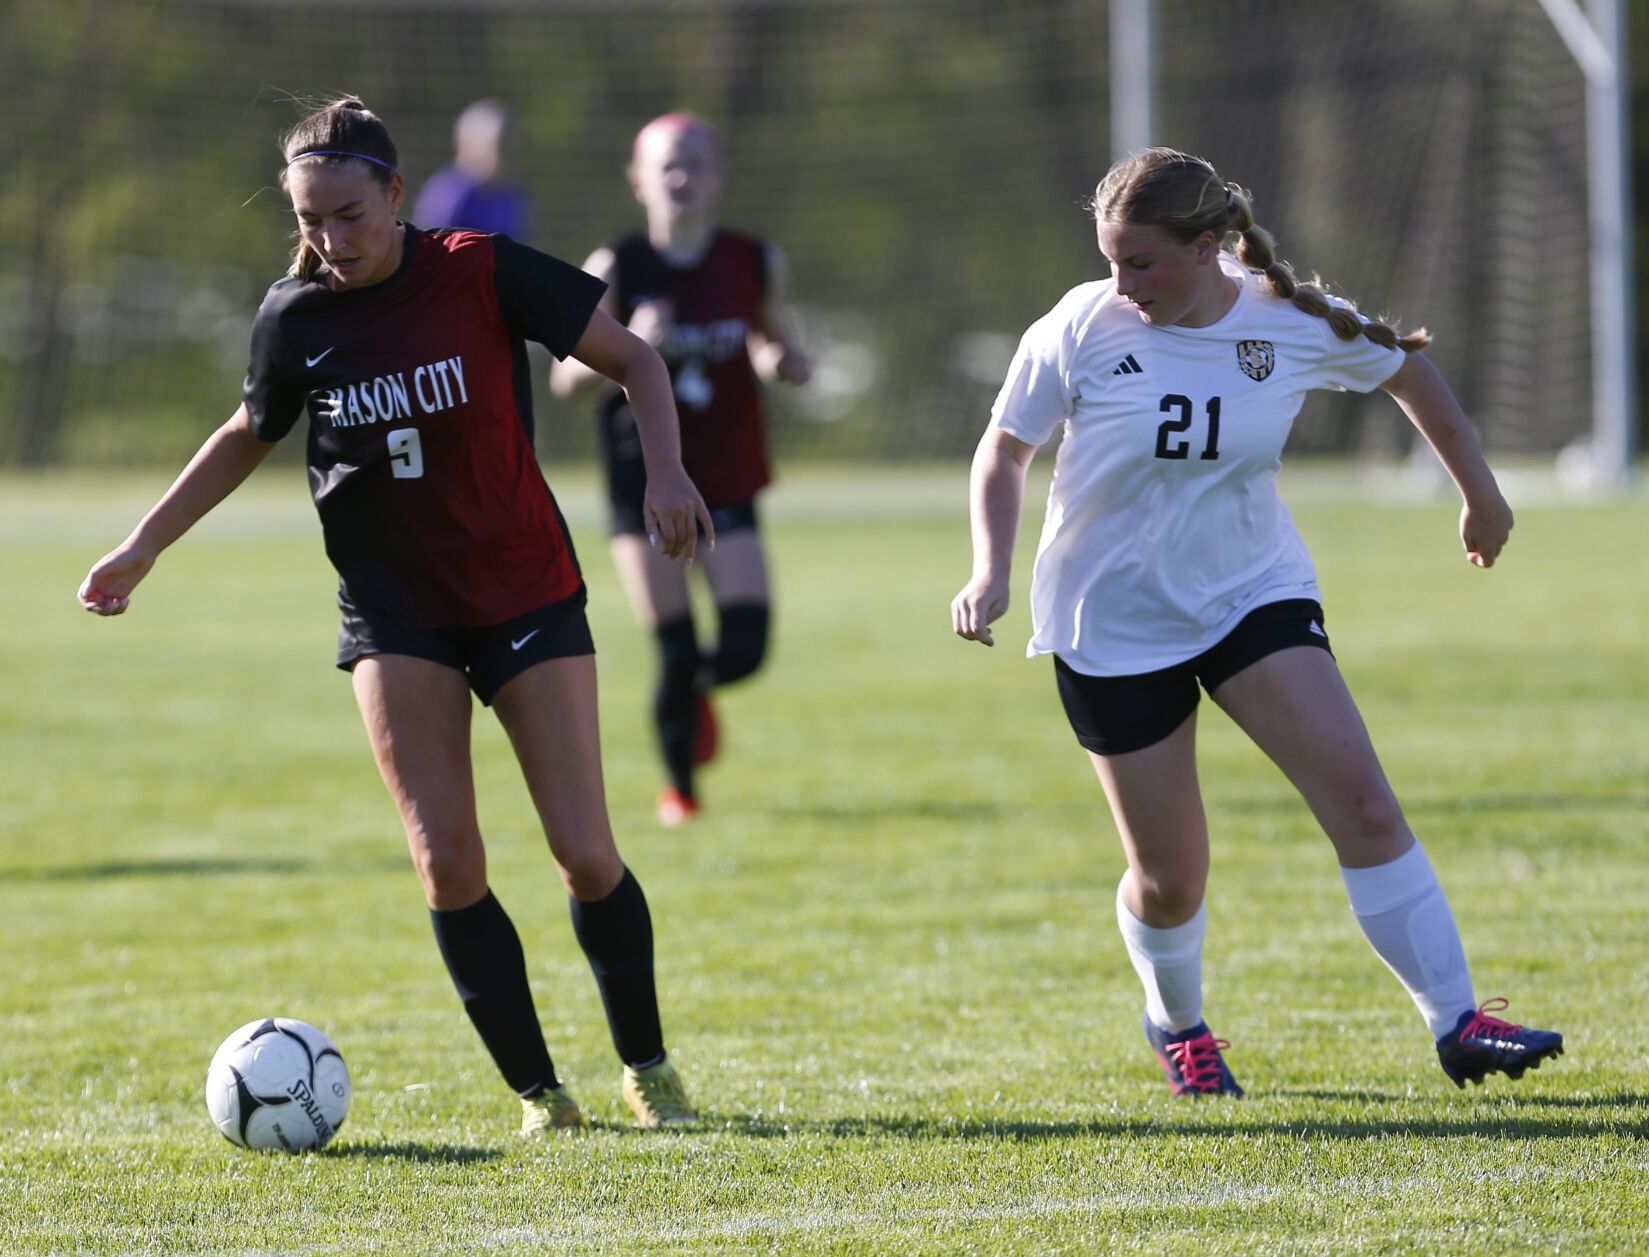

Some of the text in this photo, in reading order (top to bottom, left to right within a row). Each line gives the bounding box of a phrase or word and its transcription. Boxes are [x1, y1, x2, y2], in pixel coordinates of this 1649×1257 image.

[414, 356, 468, 413] CITY
[387, 428, 424, 478] 9
[1155, 394, 1221, 460] 21
